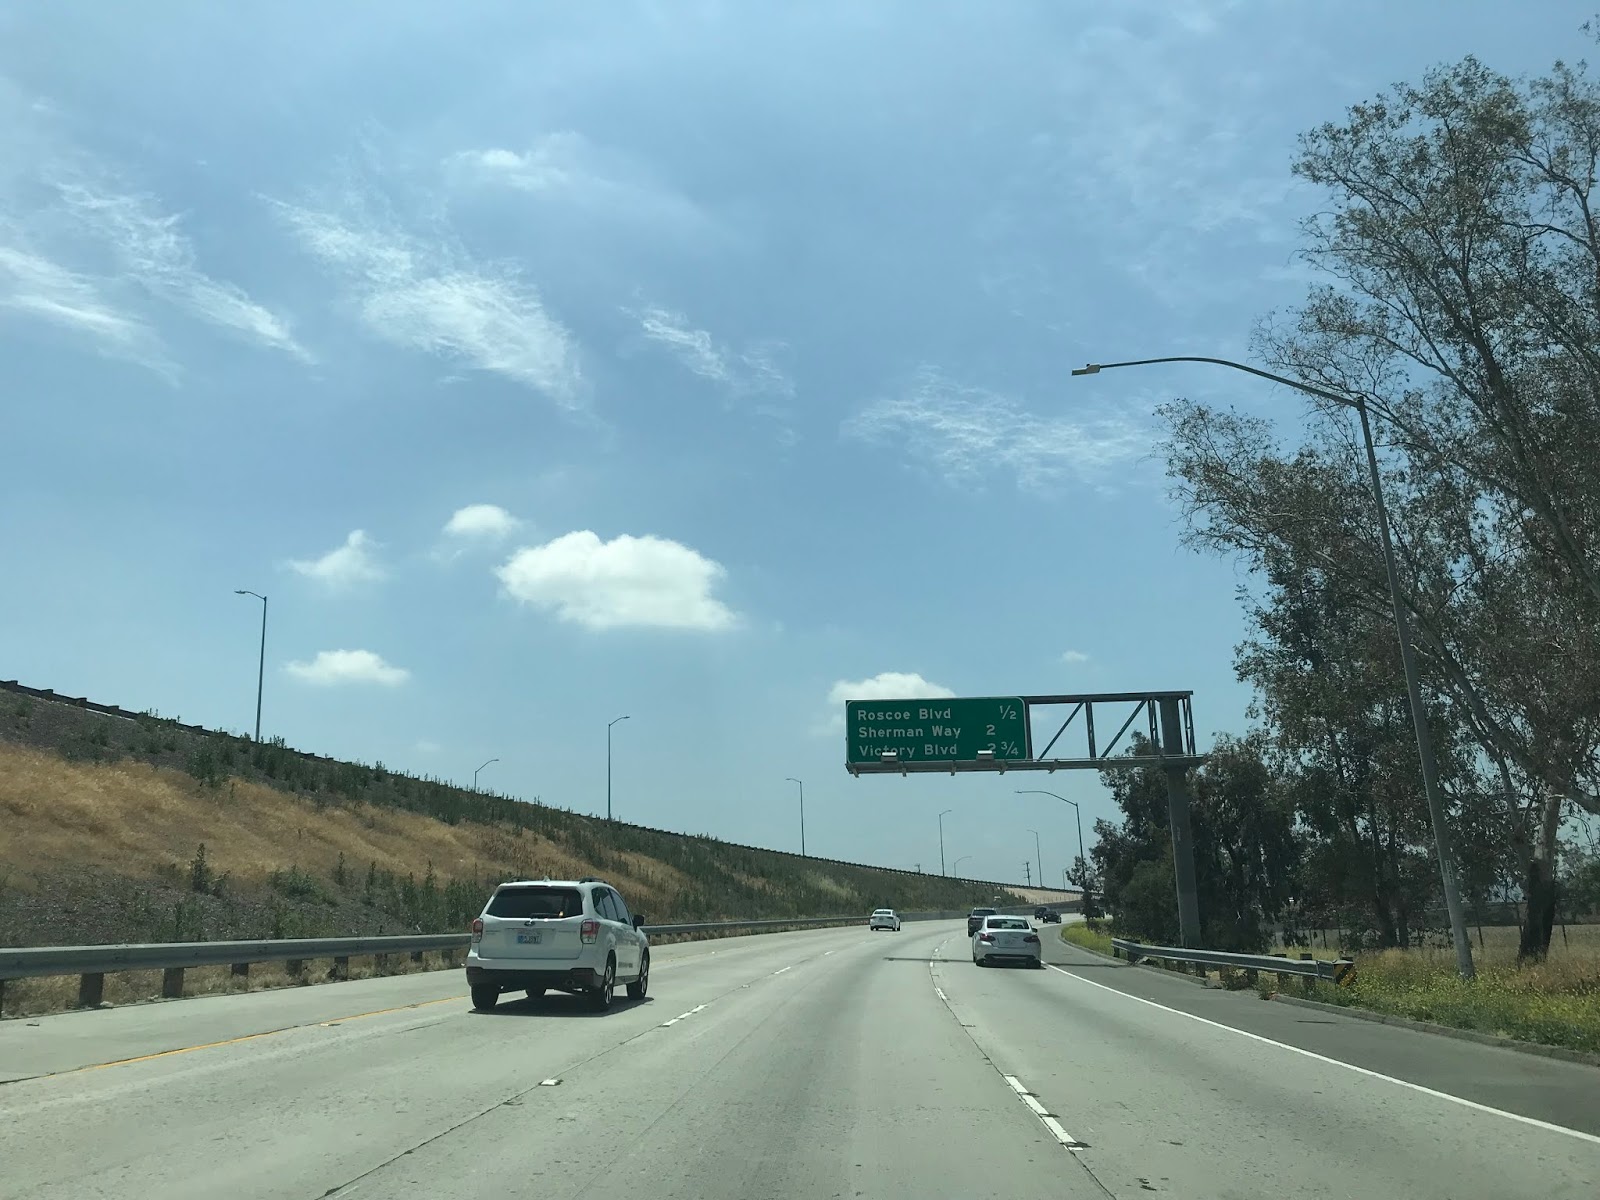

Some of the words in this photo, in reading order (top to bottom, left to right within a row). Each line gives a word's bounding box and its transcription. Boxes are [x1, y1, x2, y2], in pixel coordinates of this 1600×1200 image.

[857, 709, 910, 721] Roscoe
[919, 708, 951, 720] Blvd
[858, 726, 923, 738] Sherman
[931, 725, 961, 738] Way
[986, 724, 995, 736] 2
[924, 743, 957, 755] Blvd
